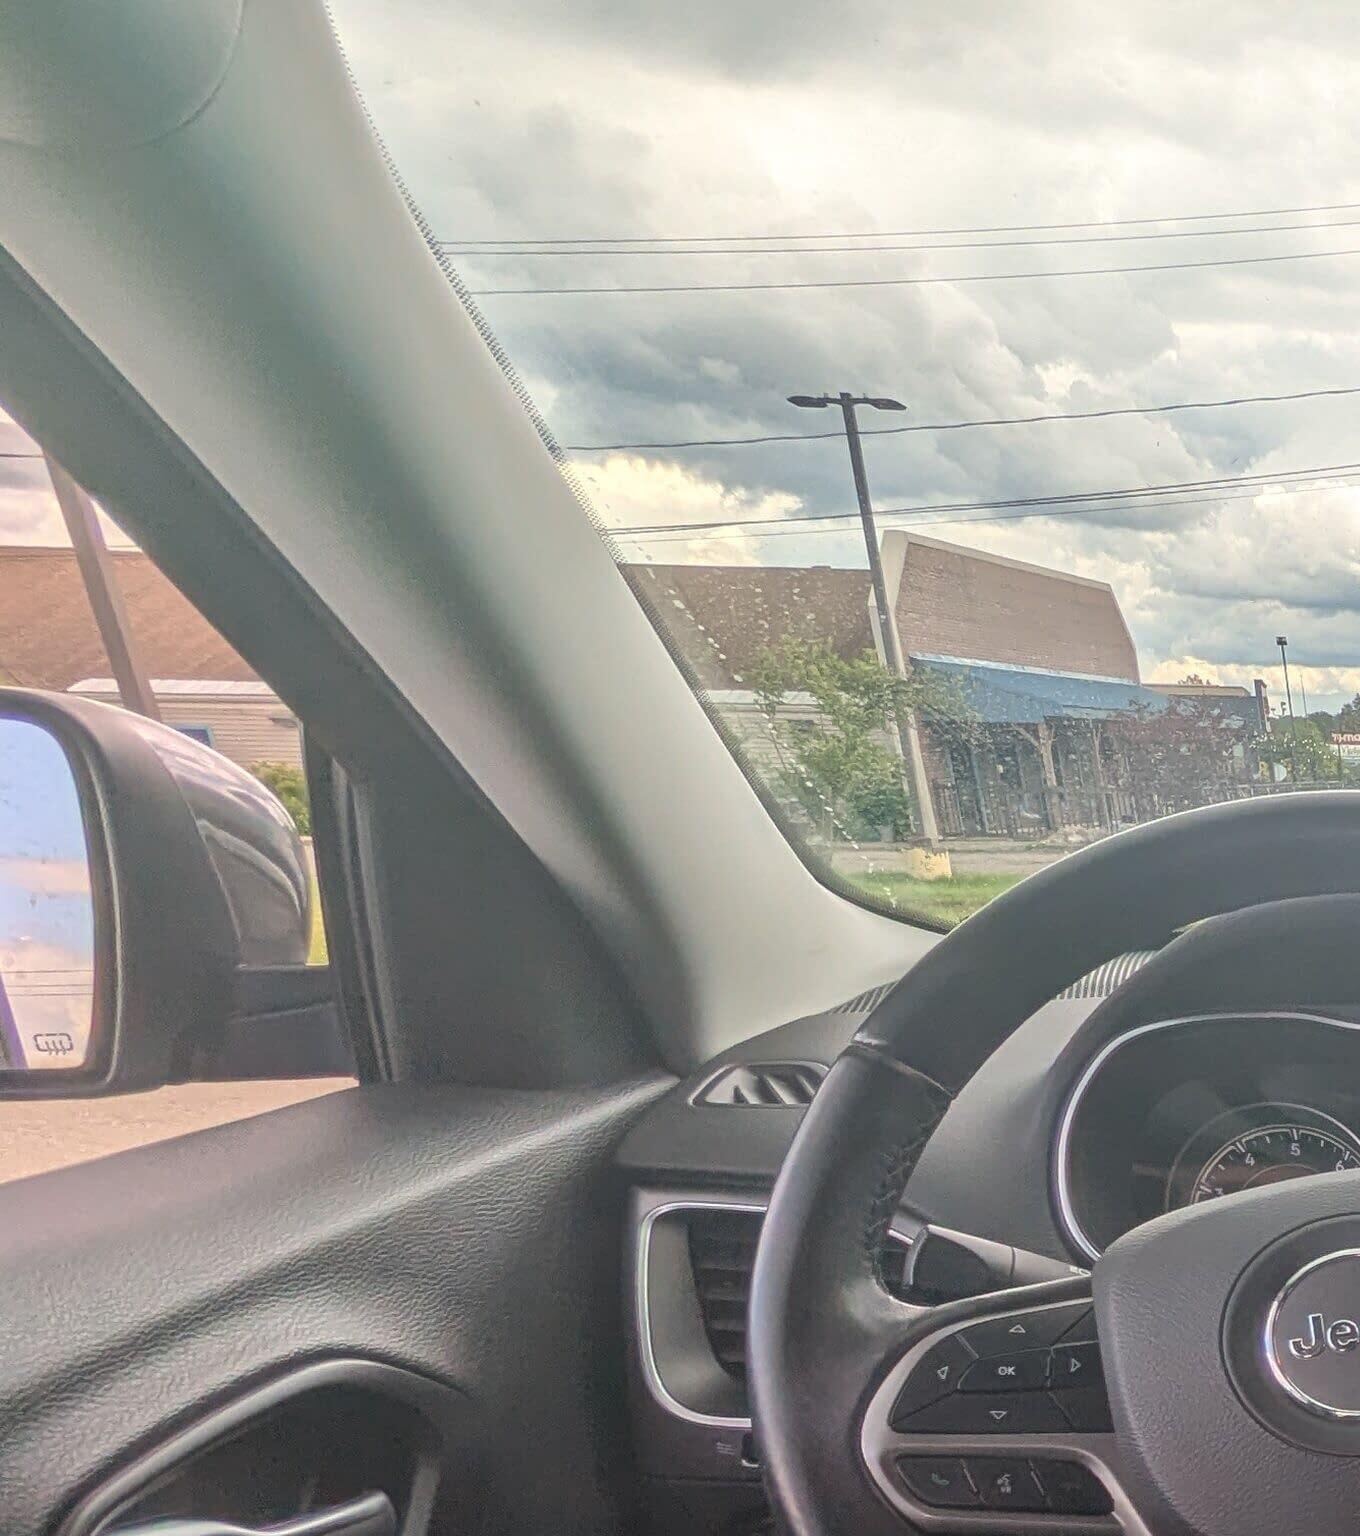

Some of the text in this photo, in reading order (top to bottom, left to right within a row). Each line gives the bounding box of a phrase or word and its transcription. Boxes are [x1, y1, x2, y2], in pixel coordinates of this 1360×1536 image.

[1291, 1143, 1300, 1156] 5
[1245, 1153, 1255, 1166] 4
[1336, 1160, 1345, 1173] 6
[998, 1366, 1016, 1376] OK
